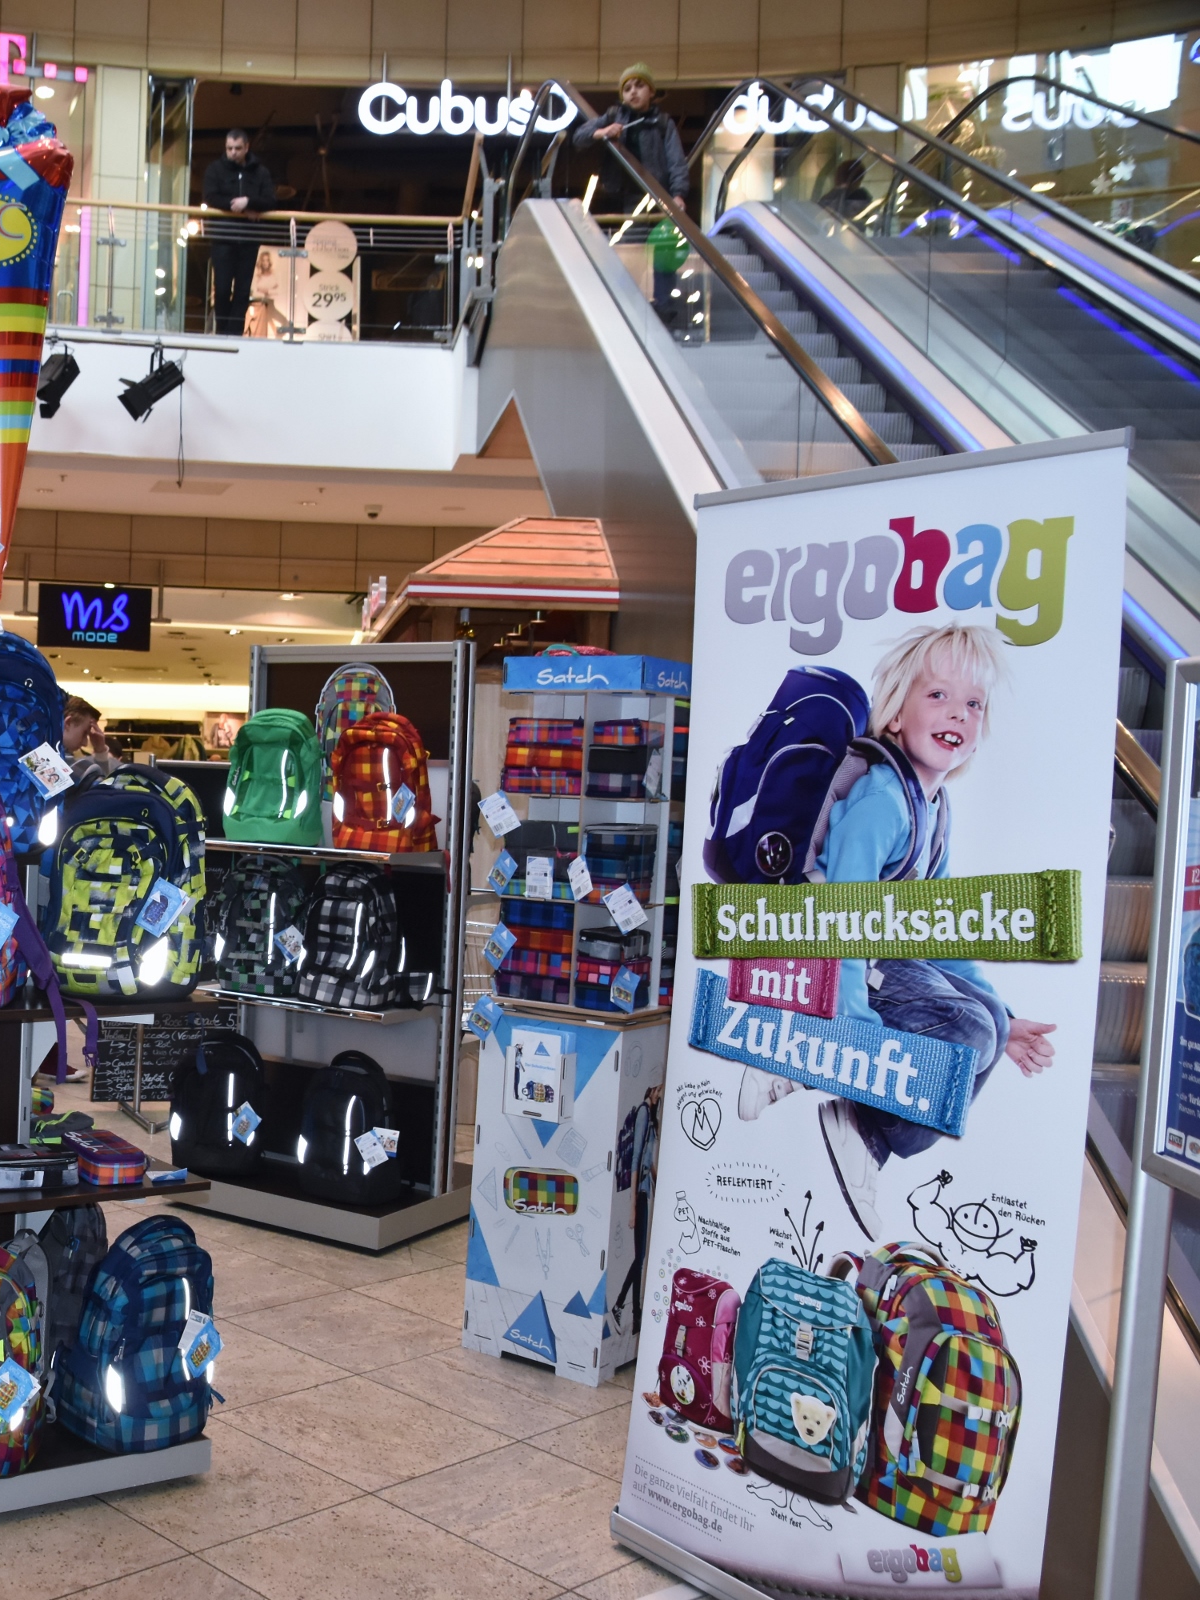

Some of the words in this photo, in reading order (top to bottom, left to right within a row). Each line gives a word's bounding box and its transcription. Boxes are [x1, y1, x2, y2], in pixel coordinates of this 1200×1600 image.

[358, 78, 537, 136] Cubus
[724, 515, 1075, 656] ergobag
[536, 665, 610, 686] Satch
[657, 669, 689, 692] Satch
[716, 892, 1036, 943] Schulrucksäcke
[750, 960, 811, 1005] mit
[715, 1000, 931, 1113] Zukunft.
[716, 1175, 773, 1190] REFLEKTIERT
[677, 1206, 689, 1216] PET
[991, 1193, 1028, 1209] Entlastet
[697, 1215, 731, 1234] Nachhaltige
[997, 1207, 1012, 1218] den
[1015, 1210, 1046, 1226] Rücken
[701, 1226, 719, 1240] Stoffe
[720, 1235, 731, 1243] aus
[769, 1226, 793, 1241] Wächst
[702, 1237, 741, 1257] PET-Flaschen
[774, 1241, 784, 1249] mit
[509, 1328, 552, 1355] Satch
[896, 1366, 913, 1405] Satch
[632, 1479, 648, 1495] auf
[648, 1488, 723, 1534] www.ergobag.de
[634, 1463, 649, 1480] Die
[649, 1473, 676, 1495] ganze
[676, 1484, 709, 1511] Vielfalt
[710, 1501, 739, 1525] findet
[739, 1516, 755, 1533] Ihr
[770, 1507, 788, 1523] Steht
[789, 1517, 802, 1529] fest
[866, 1543, 963, 1584] ergobag
